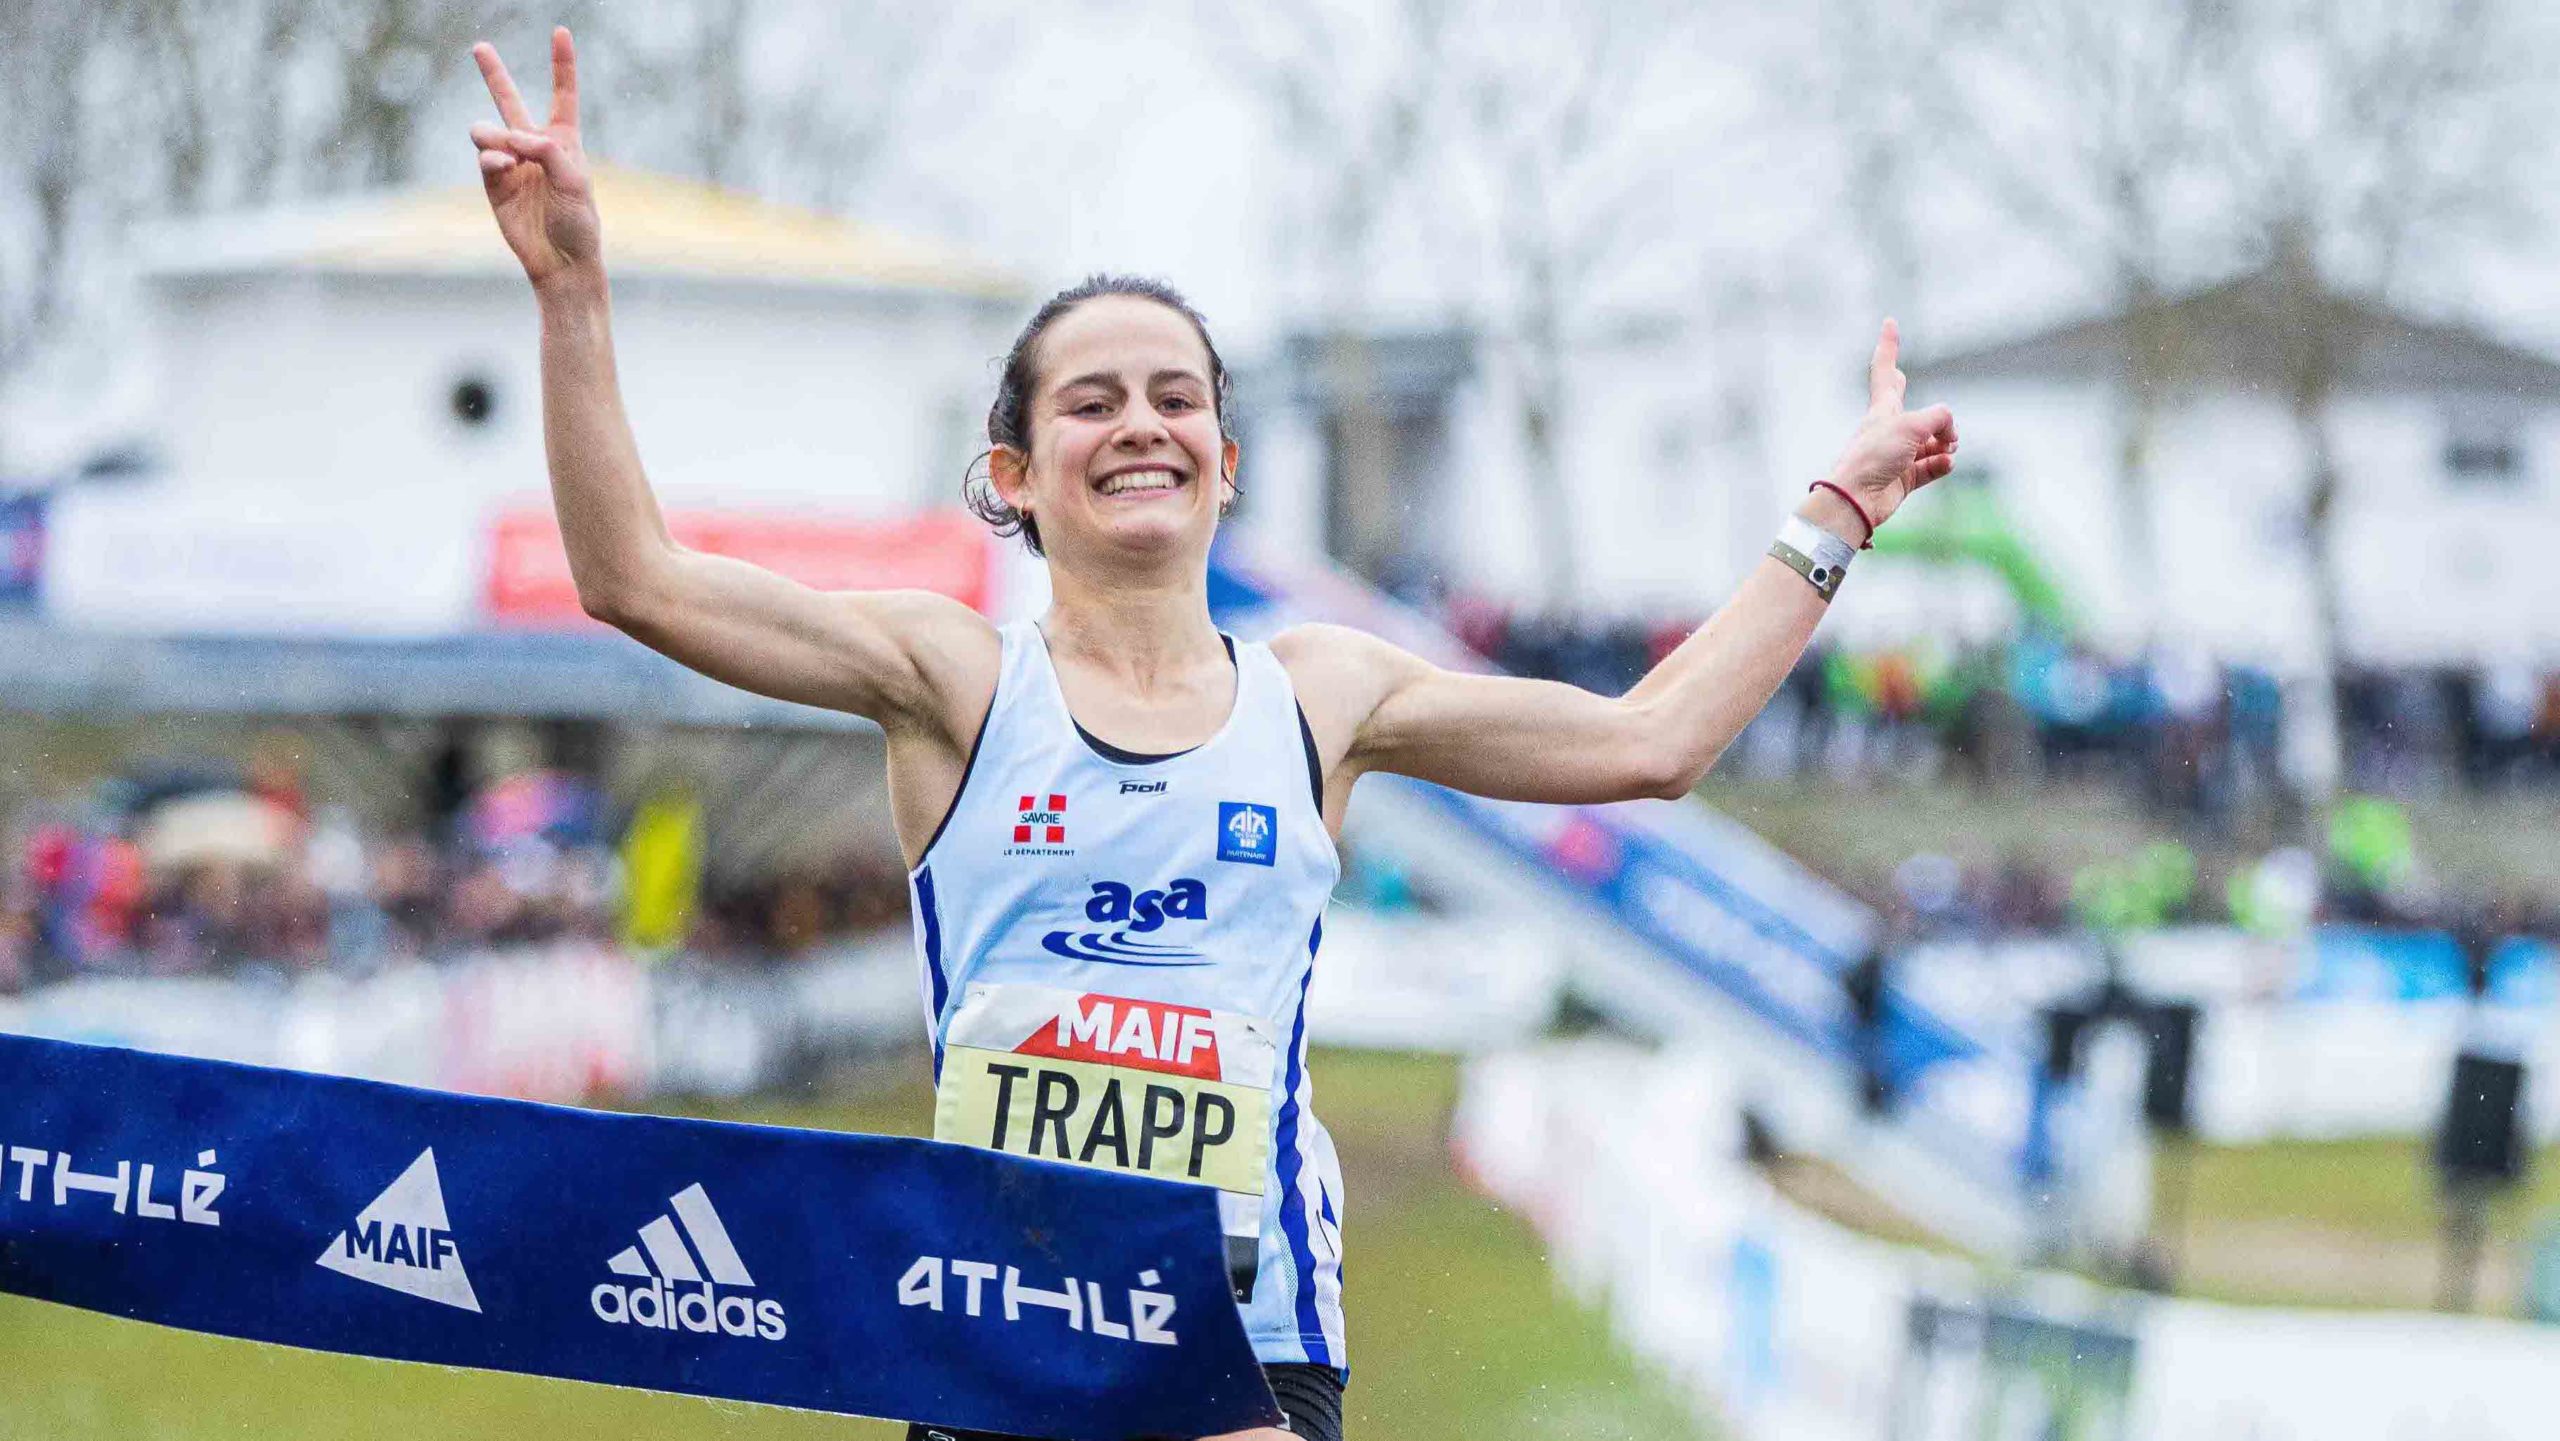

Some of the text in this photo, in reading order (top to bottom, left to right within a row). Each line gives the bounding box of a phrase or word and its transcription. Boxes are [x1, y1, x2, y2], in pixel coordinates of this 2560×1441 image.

[1119, 781, 1168, 795] poll
[1020, 812, 1060, 824] SAVOIE
[1016, 848, 1075, 857] DÉPARTEMENT
[1085, 878, 1207, 932] asa
[1056, 1002, 1216, 1064] MAIF
[987, 1062, 1236, 1177] TRAPP
[0, 1144, 226, 1227] THLÉ
[345, 1220, 456, 1271] MAIF
[591, 1276, 787, 1341] adidas
[898, 1255, 1179, 1346] ATHLÉ
